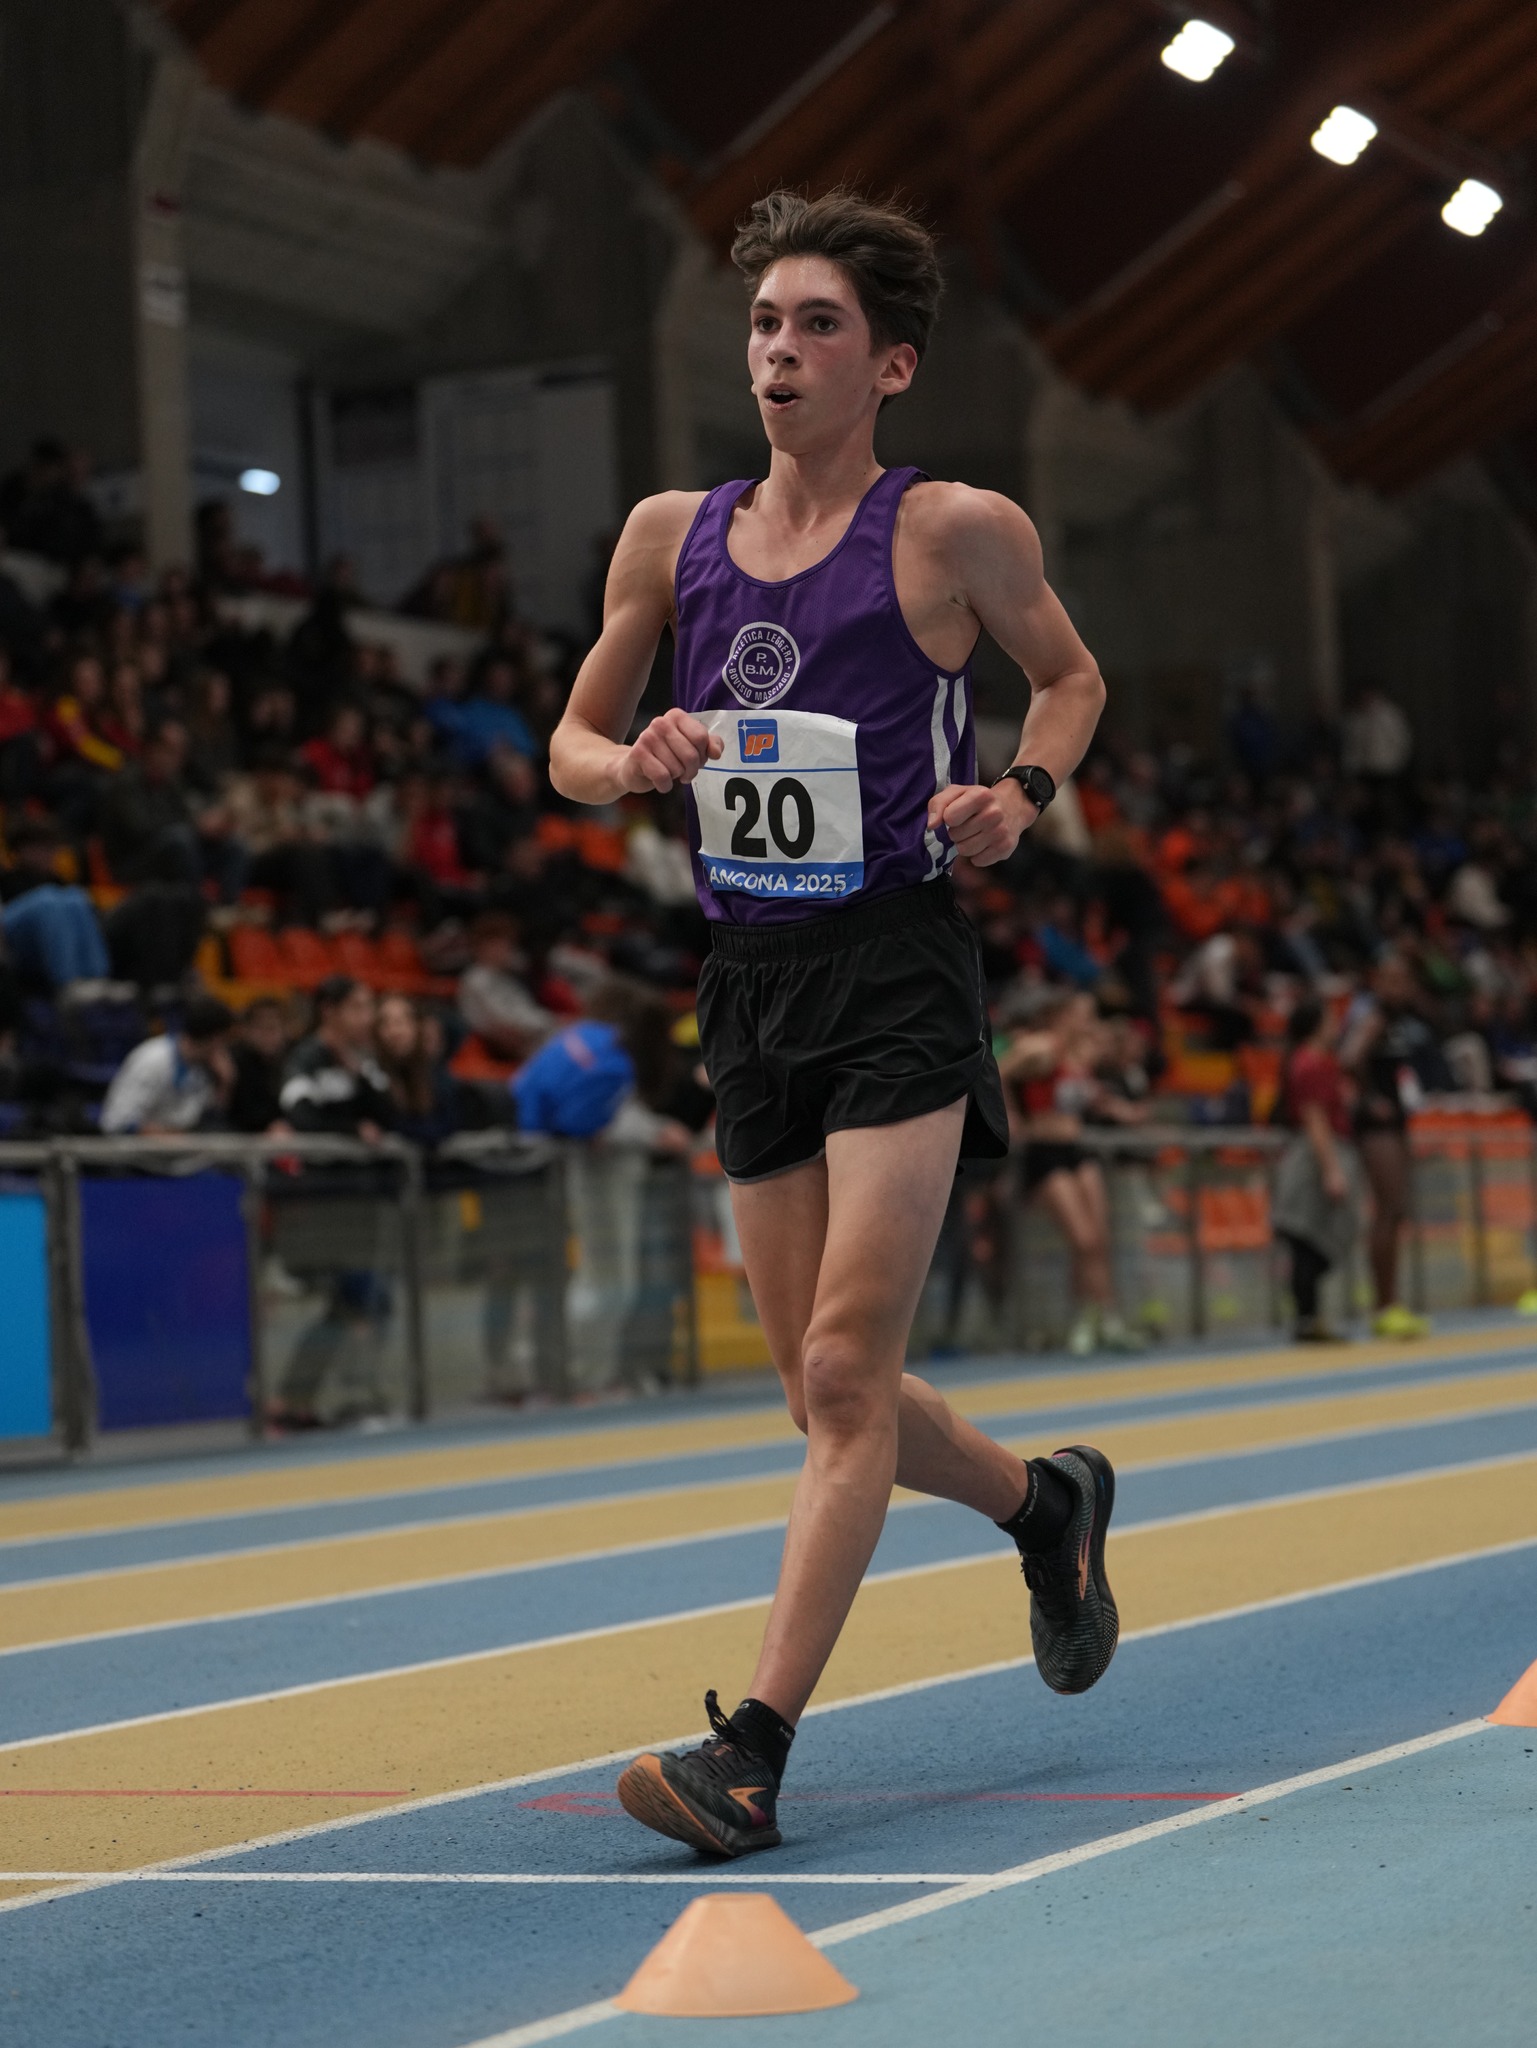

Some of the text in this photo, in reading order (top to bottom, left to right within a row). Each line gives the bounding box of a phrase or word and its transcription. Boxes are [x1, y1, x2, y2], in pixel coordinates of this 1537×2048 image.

[732, 630, 793, 664] ATLETICA LEGGERA
[756, 652, 767, 663] P.
[728, 667, 790, 701] BOVISIO MASCIAGO
[744, 734, 775, 756] IP
[724, 777, 815, 859] 20
[710, 866, 847, 892] ANCONA 2025
